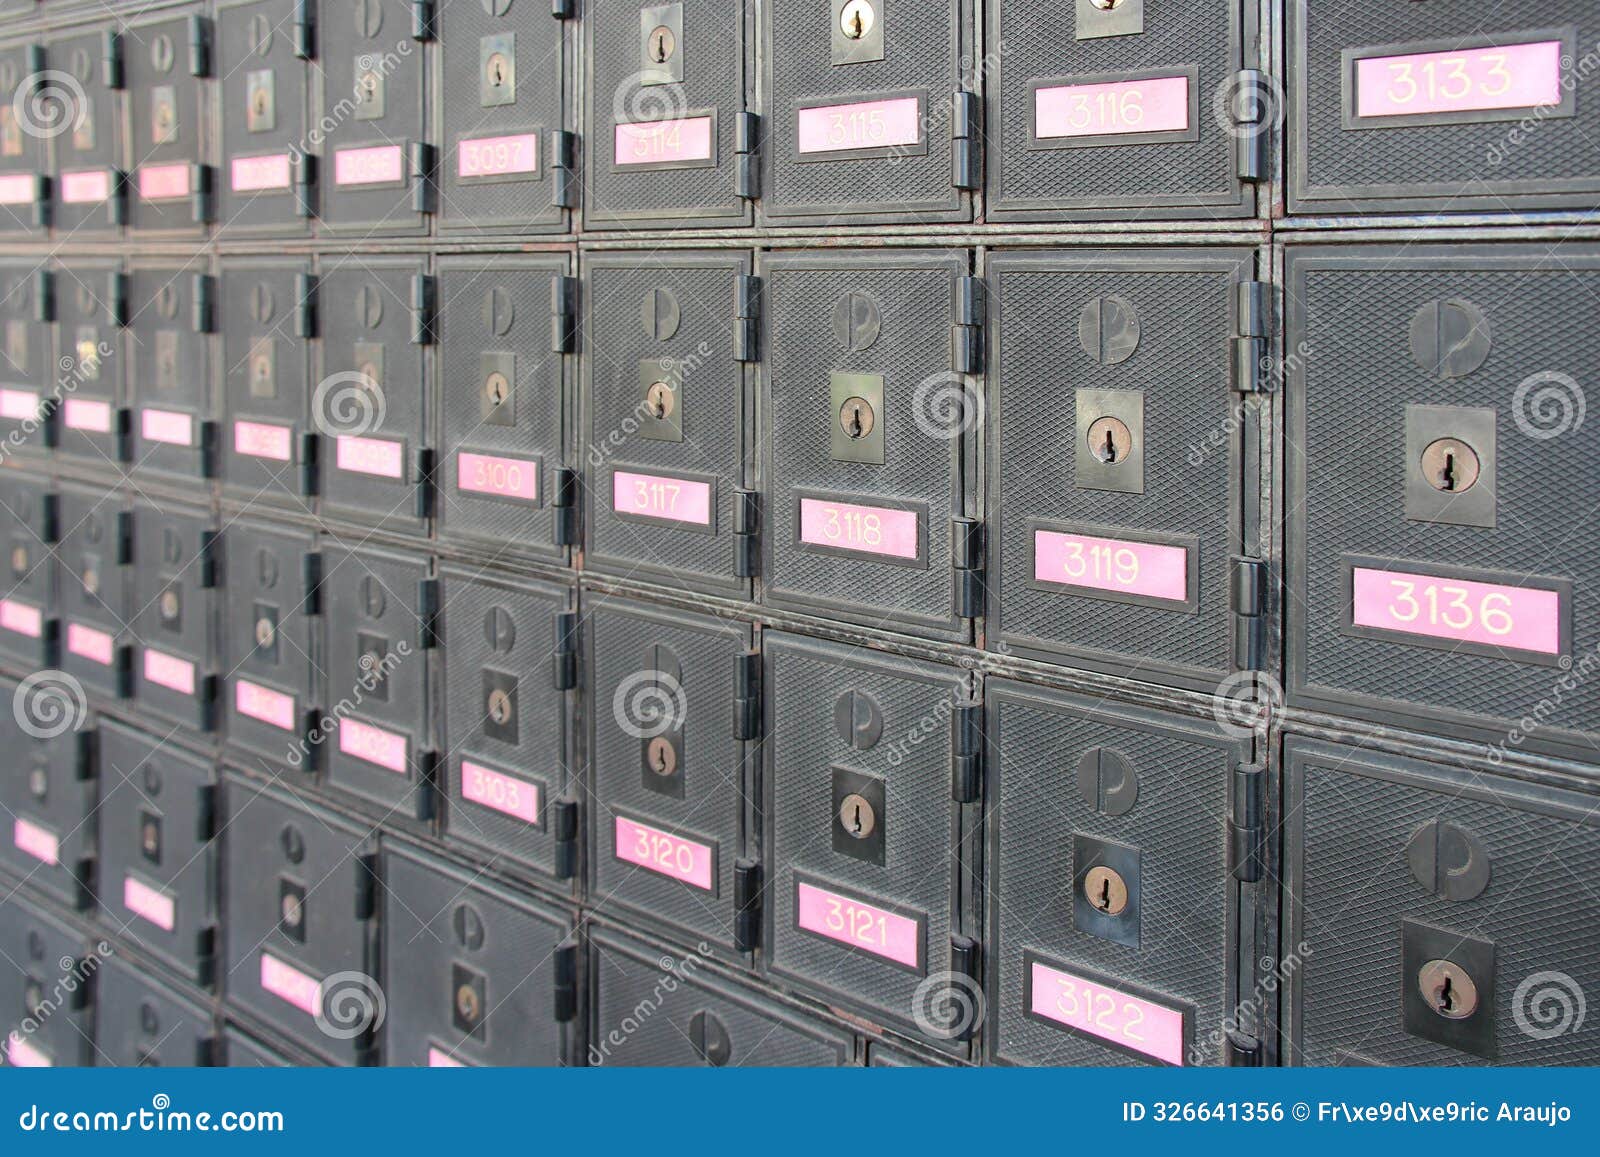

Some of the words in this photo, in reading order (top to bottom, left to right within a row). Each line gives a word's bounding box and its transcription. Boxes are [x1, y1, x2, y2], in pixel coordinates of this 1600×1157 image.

[1386, 54, 1512, 103] 3133
[828, 109, 886, 145] 3115
[1068, 90, 1144, 129] 3116
[466, 142, 522, 172] 3097
[634, 125, 682, 157] 3114
[473, 460, 522, 492] 3100
[634, 480, 681, 513] 3117
[823, 508, 881, 545] 3118
[1063, 541, 1139, 585] 3119
[1389, 580, 1513, 634] 3136
[472, 770, 520, 809] 3103
[635, 828, 694, 874] 3120
[825, 898, 888, 947] 3121
[1056, 978, 1145, 1042] 3122
